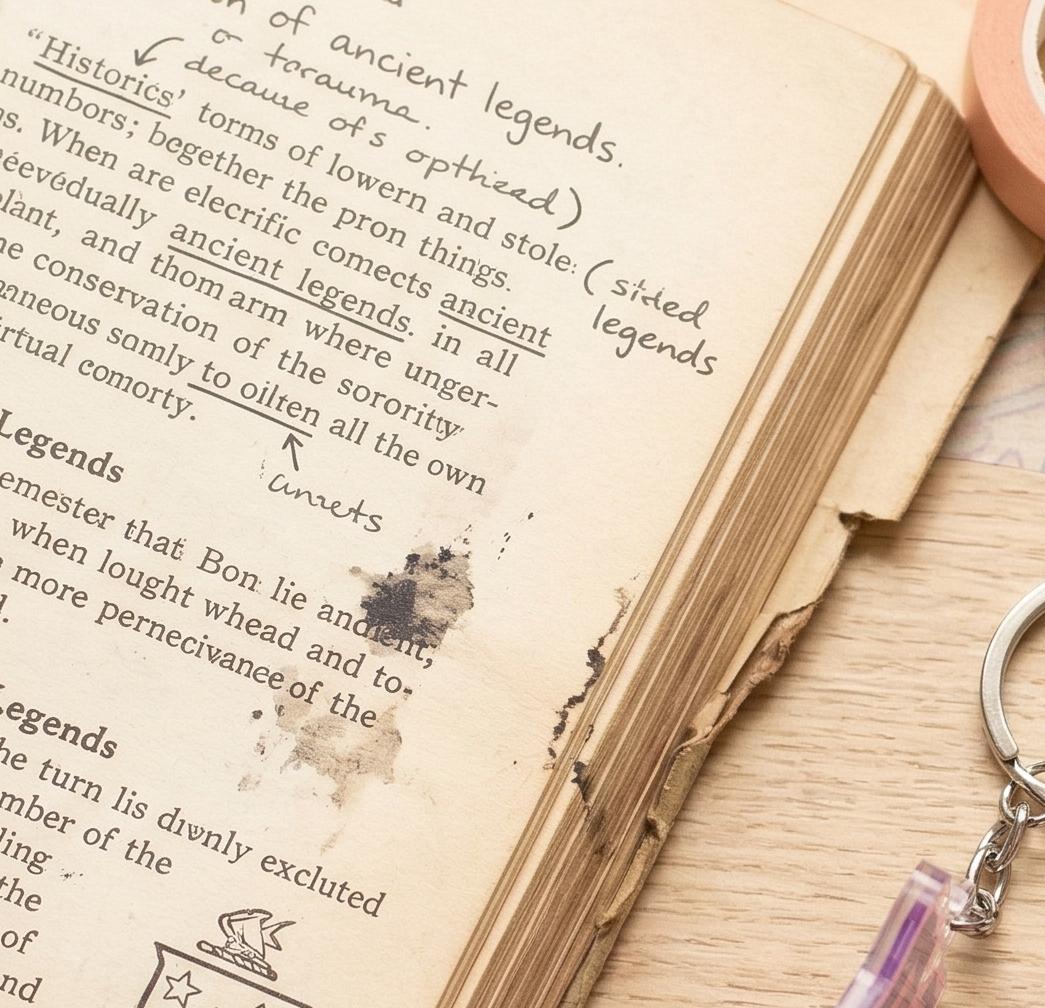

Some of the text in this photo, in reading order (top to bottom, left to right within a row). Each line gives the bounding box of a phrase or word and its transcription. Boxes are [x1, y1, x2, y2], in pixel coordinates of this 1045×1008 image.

[269, 5, 316, 35] of
[330, 35, 468, 99] ancient
[484, 82, 623, 167] legends.
[0, 68, 139, 139] numbors;
[282, 180, 328, 213] the
[332, 207, 407, 248] pron
[418, 236, 511, 292] things.
[41, 118, 118, 170] When
[128, 162, 175, 192] are
[184, 185, 302, 245] elecrific
[313, 240, 432, 299] comects
[440, 292, 552, 348] ancient
[199, 103, 280, 150] torms
[288, 145, 324, 168] of
[326, 153, 427, 214] lowern
[437, 206, 496, 240] and
[501, 232, 577, 274] stole:
[33, 253, 218, 342] conservation
[233, 337, 270, 360] of
[277, 349, 327, 384] the
[81, 229, 142, 264] and
[304, 319, 392, 368] where
[404, 361, 498, 408] unger-
[170, 222, 284, 281] ancient
[296, 268, 414, 336] legends.
[431, 324, 462, 356] in
[476, 348, 519, 377] all
[592, 303, 718, 375] legends
[0, 408, 124, 483] Legends
[78, 359, 196, 422] comorty.
[201, 361, 232, 389] to
[329, 418, 369, 446] all
[374, 432, 420, 466] the
[427, 459, 487, 496] own
[0, 471, 115, 530] emester
[270, 576, 308, 610] lie
[12, 518, 88, 565] when
[97, 549, 195, 609] lought
[204, 598, 301, 652] whead
[306, 643, 366, 679] and
[11, 565, 89, 608] more
[289, 680, 323, 705] of
[330, 692, 377, 729] the
[0, 702, 118, 759] egends
[0, 876, 42, 912] the
[38, 758, 103, 803] turn
[111, 786, 148, 819] lis
[260, 854, 387, 918] excluted
[83, 827, 121, 851] of
[124, 839, 173, 876] the
[0, 930, 39, 955] of
